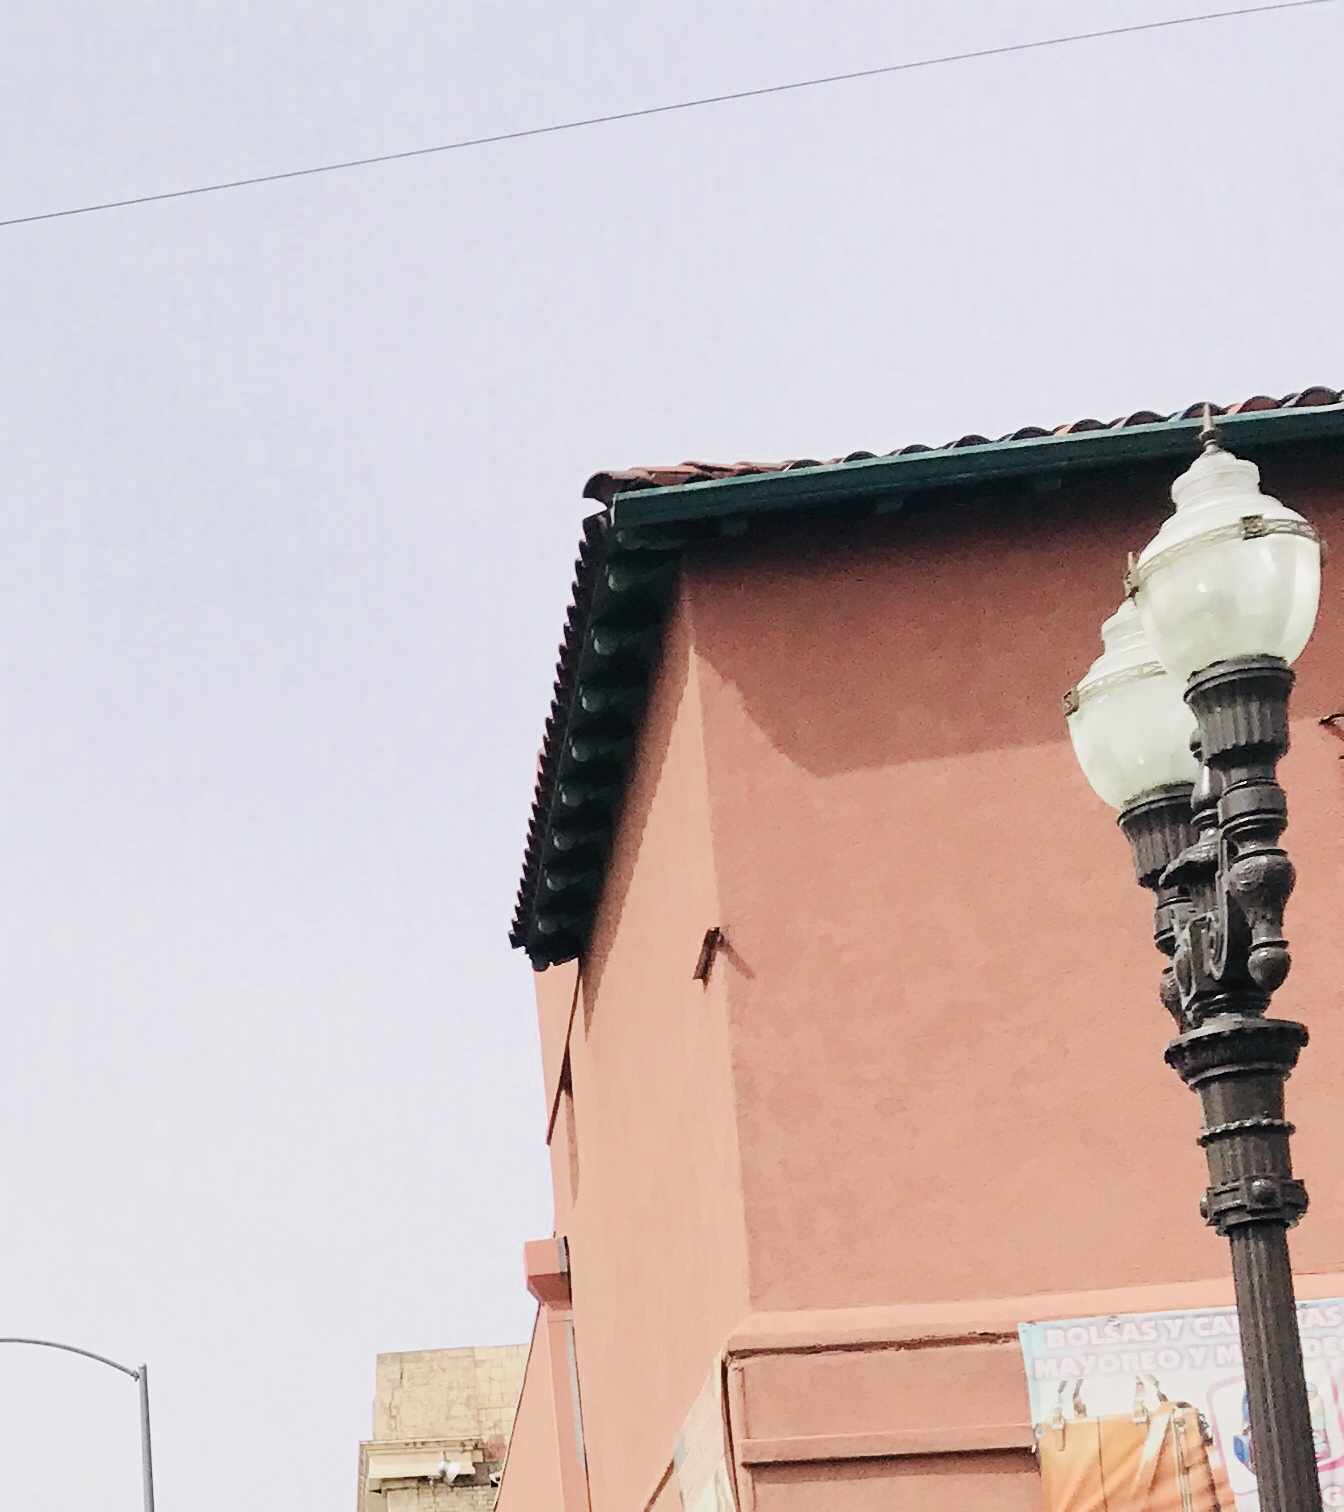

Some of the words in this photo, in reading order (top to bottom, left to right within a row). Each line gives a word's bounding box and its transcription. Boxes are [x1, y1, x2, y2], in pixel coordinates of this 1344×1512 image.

[1044, 1319, 1158, 1349] BOLSAS
[1164, 1318, 1185, 1340] Y
[1032, 1347, 1181, 1381] MAYOREO
[1187, 1345, 1207, 1367] Y
